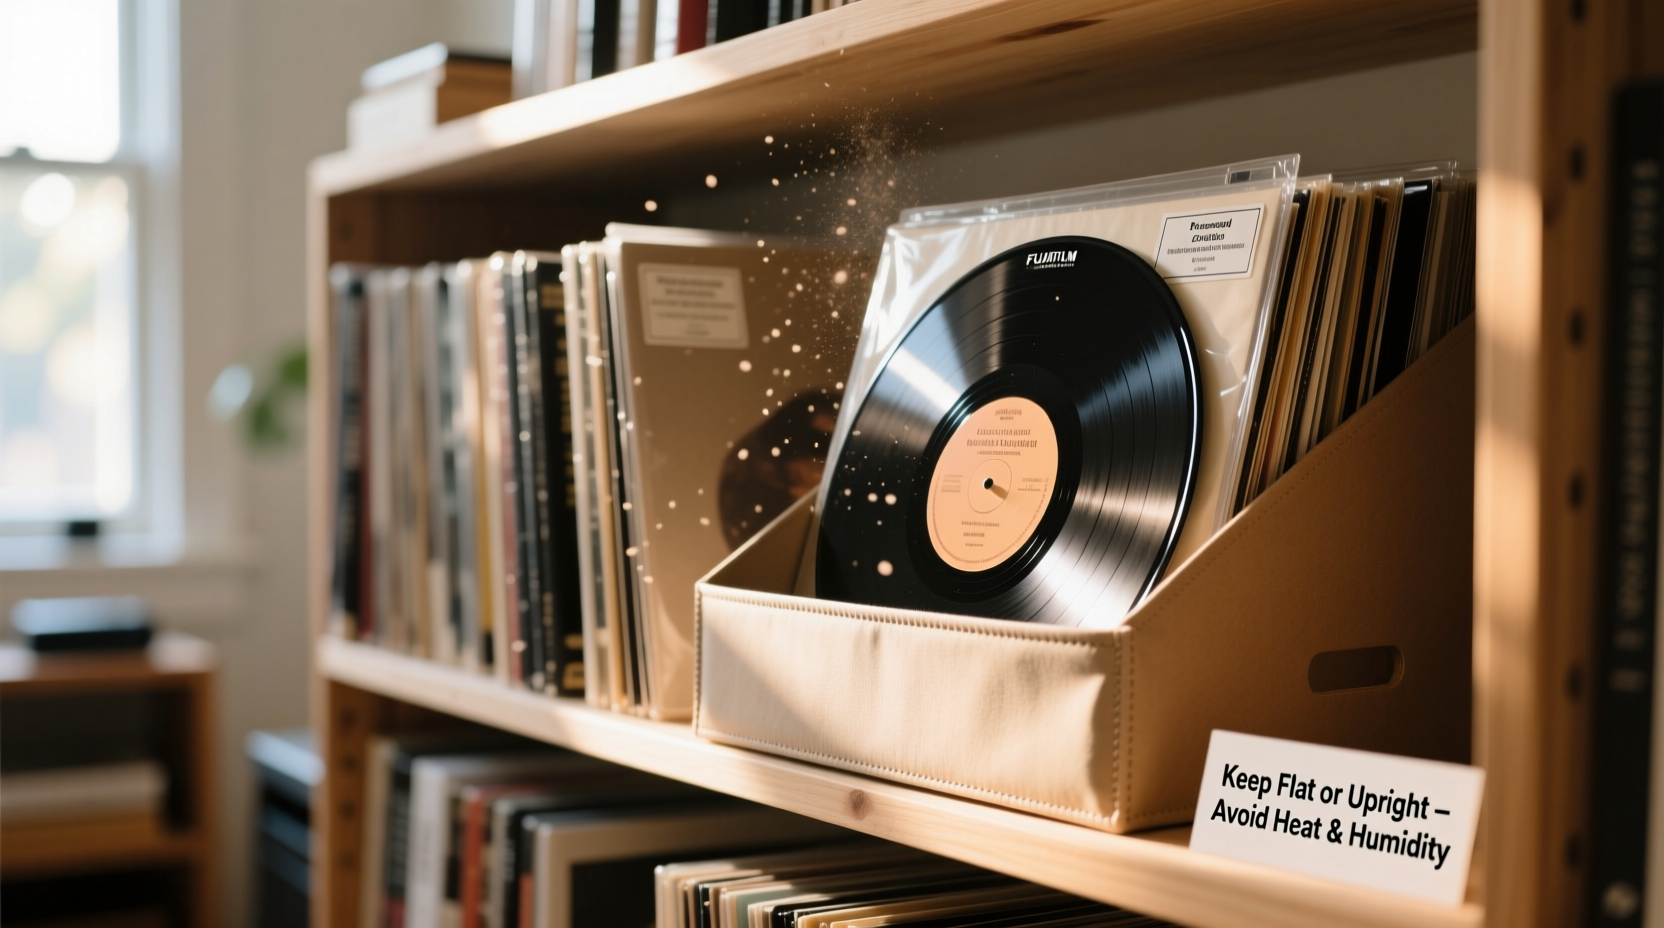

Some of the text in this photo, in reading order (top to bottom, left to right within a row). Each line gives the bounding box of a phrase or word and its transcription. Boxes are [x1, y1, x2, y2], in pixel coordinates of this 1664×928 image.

[1221, 763, 1272, 800] Keep
[1276, 772, 1317, 802] Flat
[1319, 785, 1344, 805] or
[1347, 783, 1430, 823] Upright
[1210, 798, 1452, 871] Avoid Heat & Humidity
